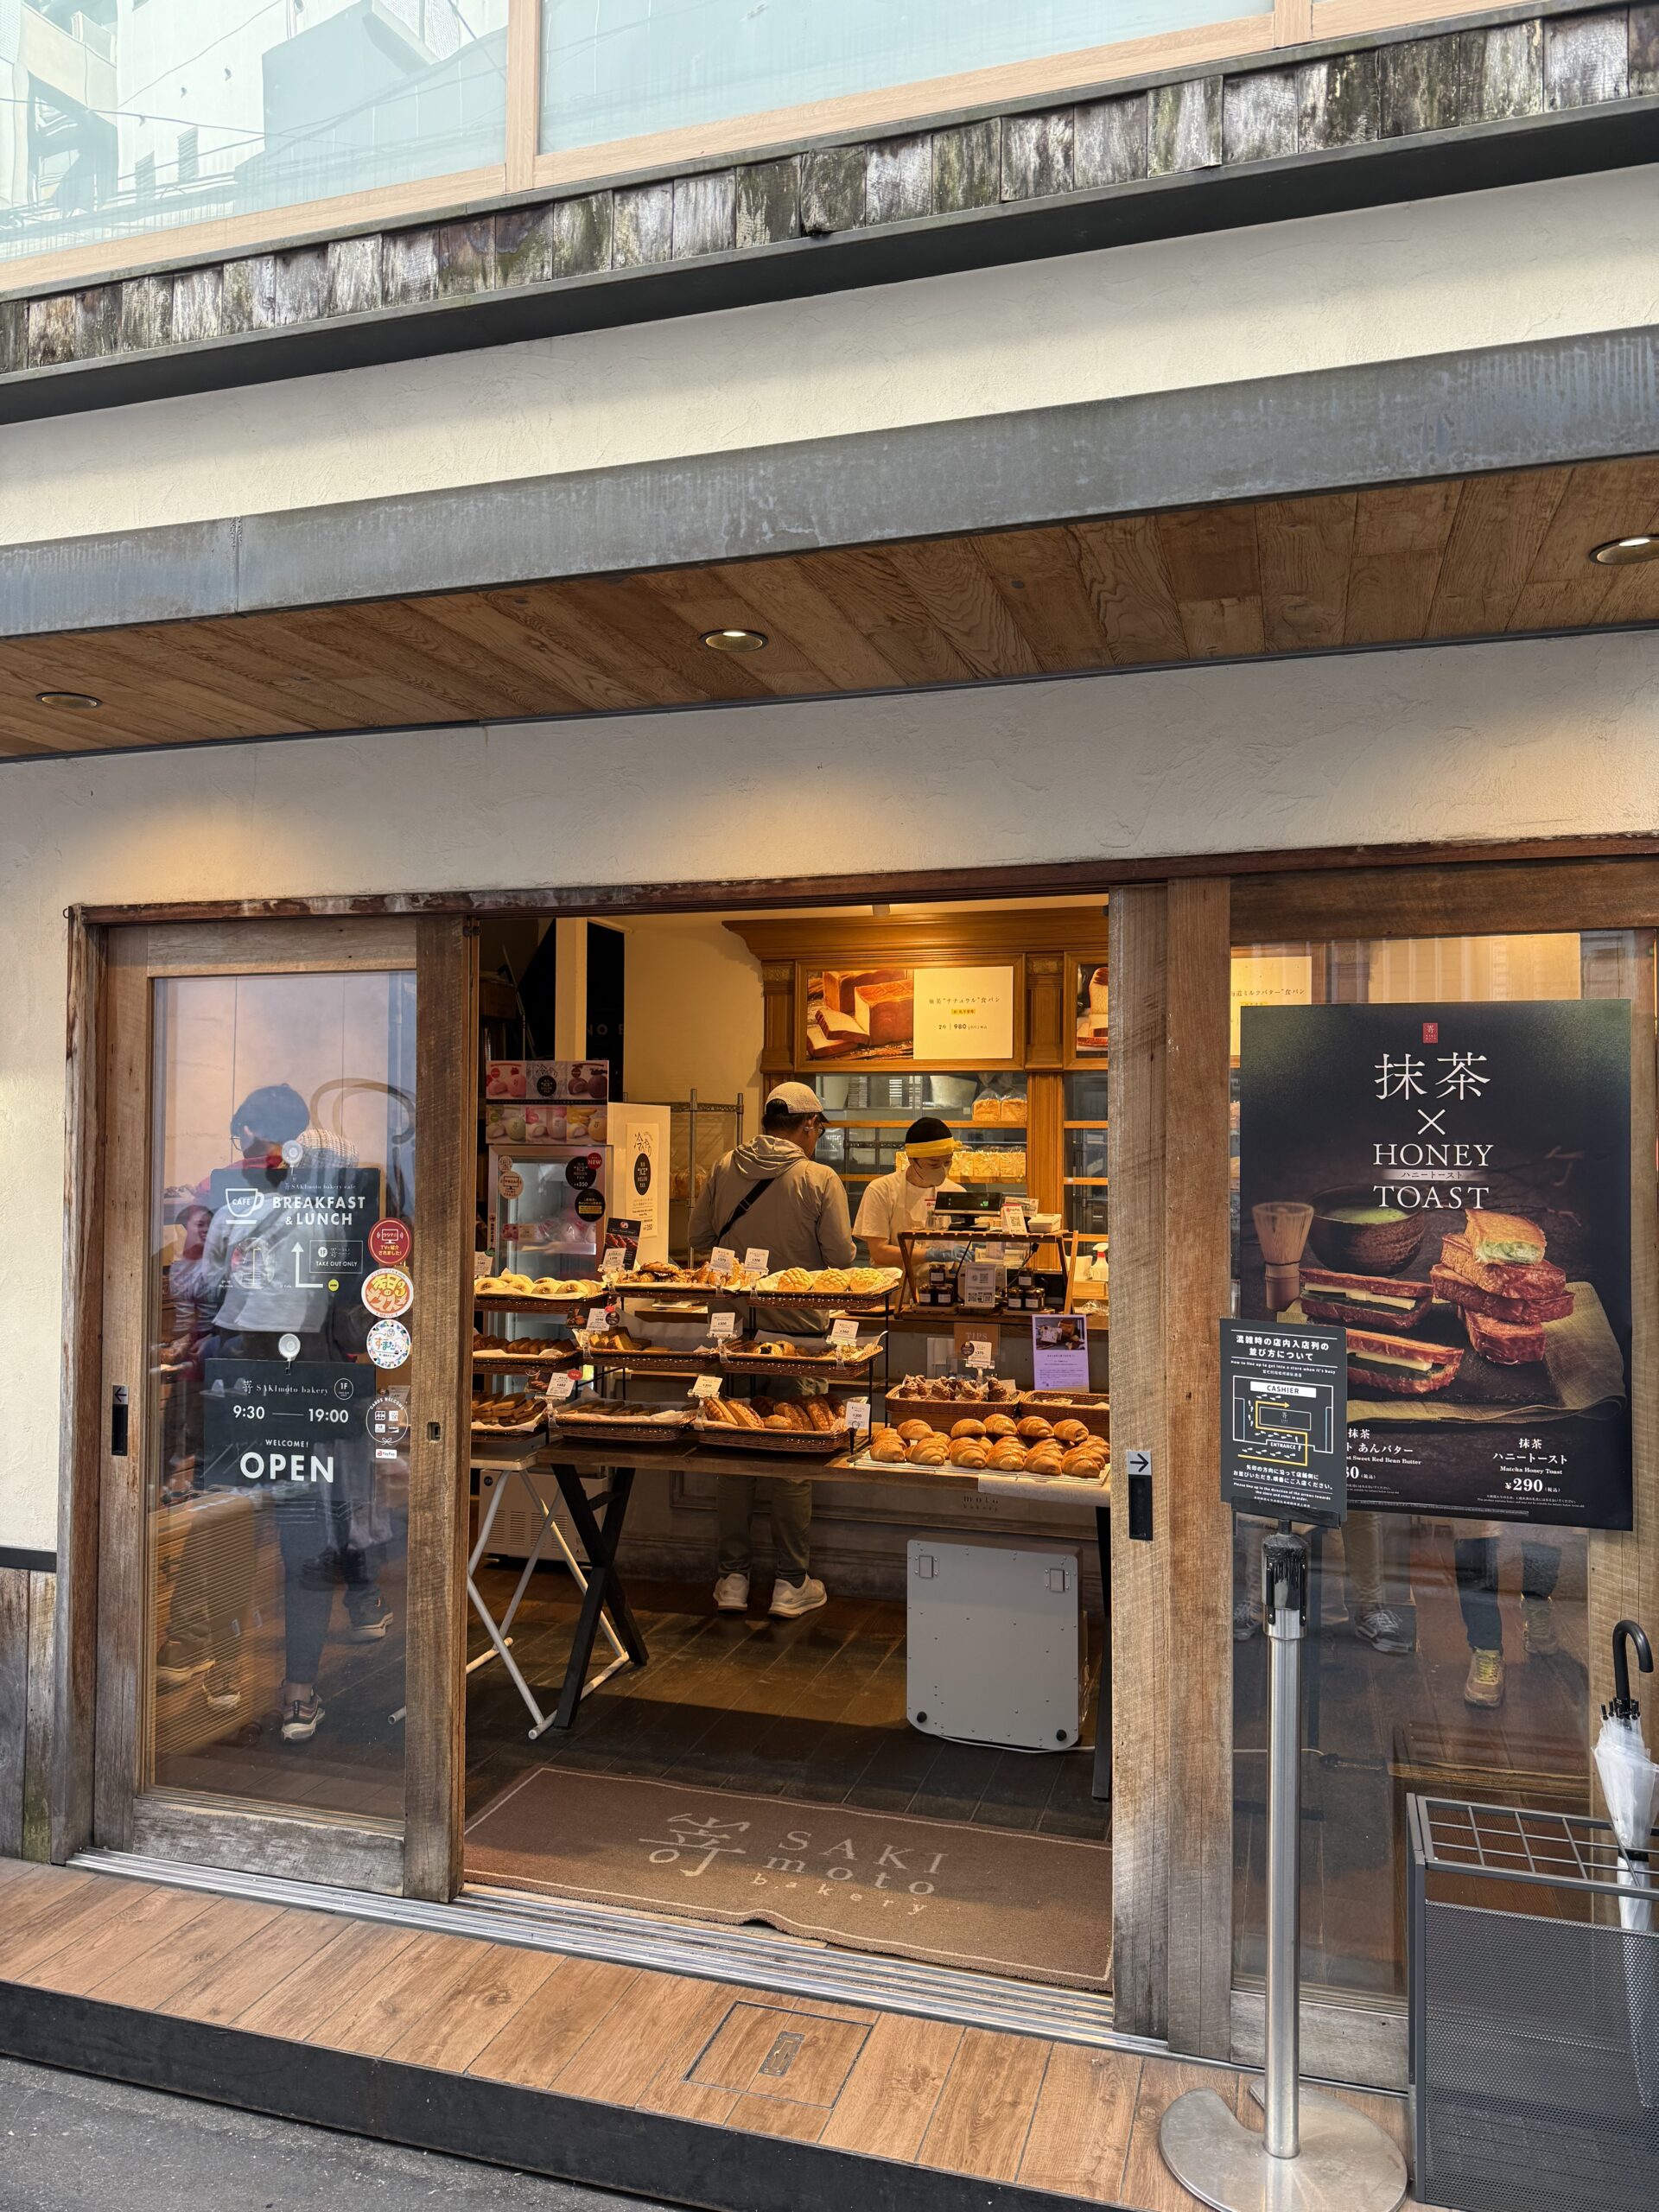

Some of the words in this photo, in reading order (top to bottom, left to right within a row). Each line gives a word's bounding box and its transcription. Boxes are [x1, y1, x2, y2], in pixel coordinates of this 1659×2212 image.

[1374, 1052, 1491, 1100] 抹茶
[1372, 1143, 1494, 1166] HONEY
[1401, 1171, 1463, 1179] ハニートースト
[232, 1196, 251, 1205] CAFE
[272, 1196, 365, 1209] BREAKFAST
[1373, 1185, 1490, 1210] TOAST
[296, 1212, 353, 1225] LUNCH
[966, 1332, 988, 1341] TIPS
[1236, 1334, 1329, 1351] 混雑時の店内入店列の
[1249, 1348, 1313, 1361] 並び方について
[302, 1386, 328, 1396] bakery
[1267, 1384, 1300, 1395] CASHIER
[370, 1397, 384, 1410] CARDS
[385, 1396, 404, 1410] WELCOME
[233, 1405, 265, 1420] 9:30
[308, 1408, 349, 1423] 19:00
[1348, 1427, 1370, 1440] 抹茶
[265, 1439, 308, 1448] WELCOME!
[1270, 1441, 1296, 1450] ENTRANCE
[1358, 1442, 1414, 1455] あんバター
[1519, 1438, 1542, 1450] 抹茶
[1492, 1452, 1567, 1465] ハニートースト
[239, 1452, 334, 1483] OPEN
[1505, 1478, 1543, 1492] ¥290
[778, 1830, 949, 1874] SAKI
[763, 1856, 935, 1896] moto
[750, 1872, 928, 1916] bakery
